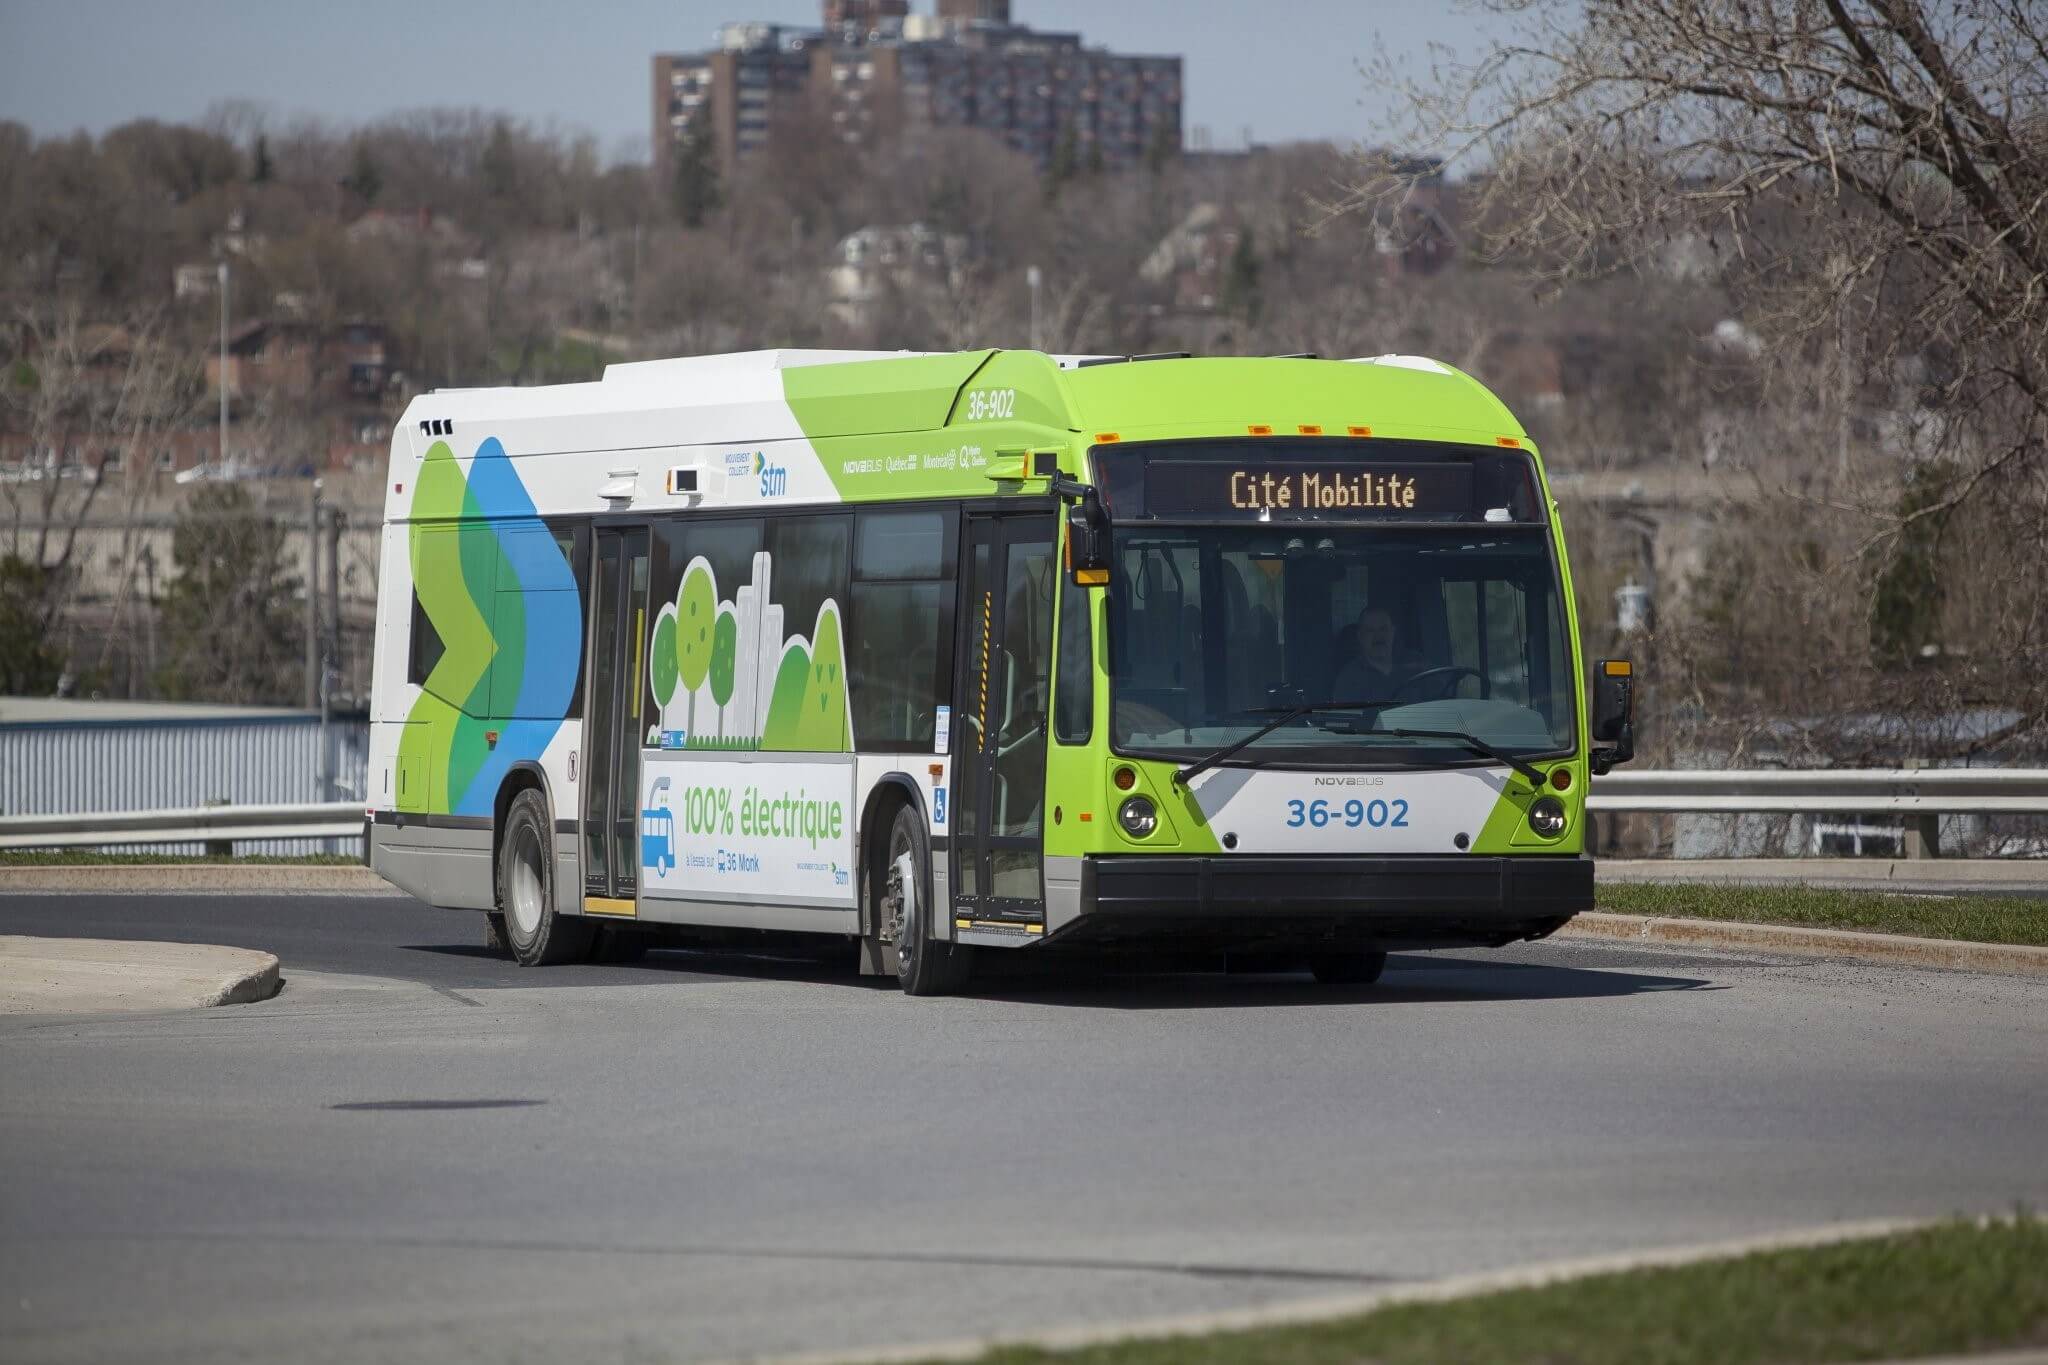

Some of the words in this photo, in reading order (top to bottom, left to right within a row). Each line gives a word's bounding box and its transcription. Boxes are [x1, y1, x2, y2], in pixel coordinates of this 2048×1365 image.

[967, 389, 1015, 420] 36-902
[760, 462, 786, 497] stm
[1231, 472, 1291, 508] Cité
[1302, 472, 1416, 508] Mobilité
[1314, 777, 1384, 786] NOVABUS
[685, 787, 733, 835] 100%
[741, 786, 842, 850] électrique
[1286, 799, 1409, 828] 36-902
[726, 853, 737, 872] 36
[738, 853, 760, 873] Monk
